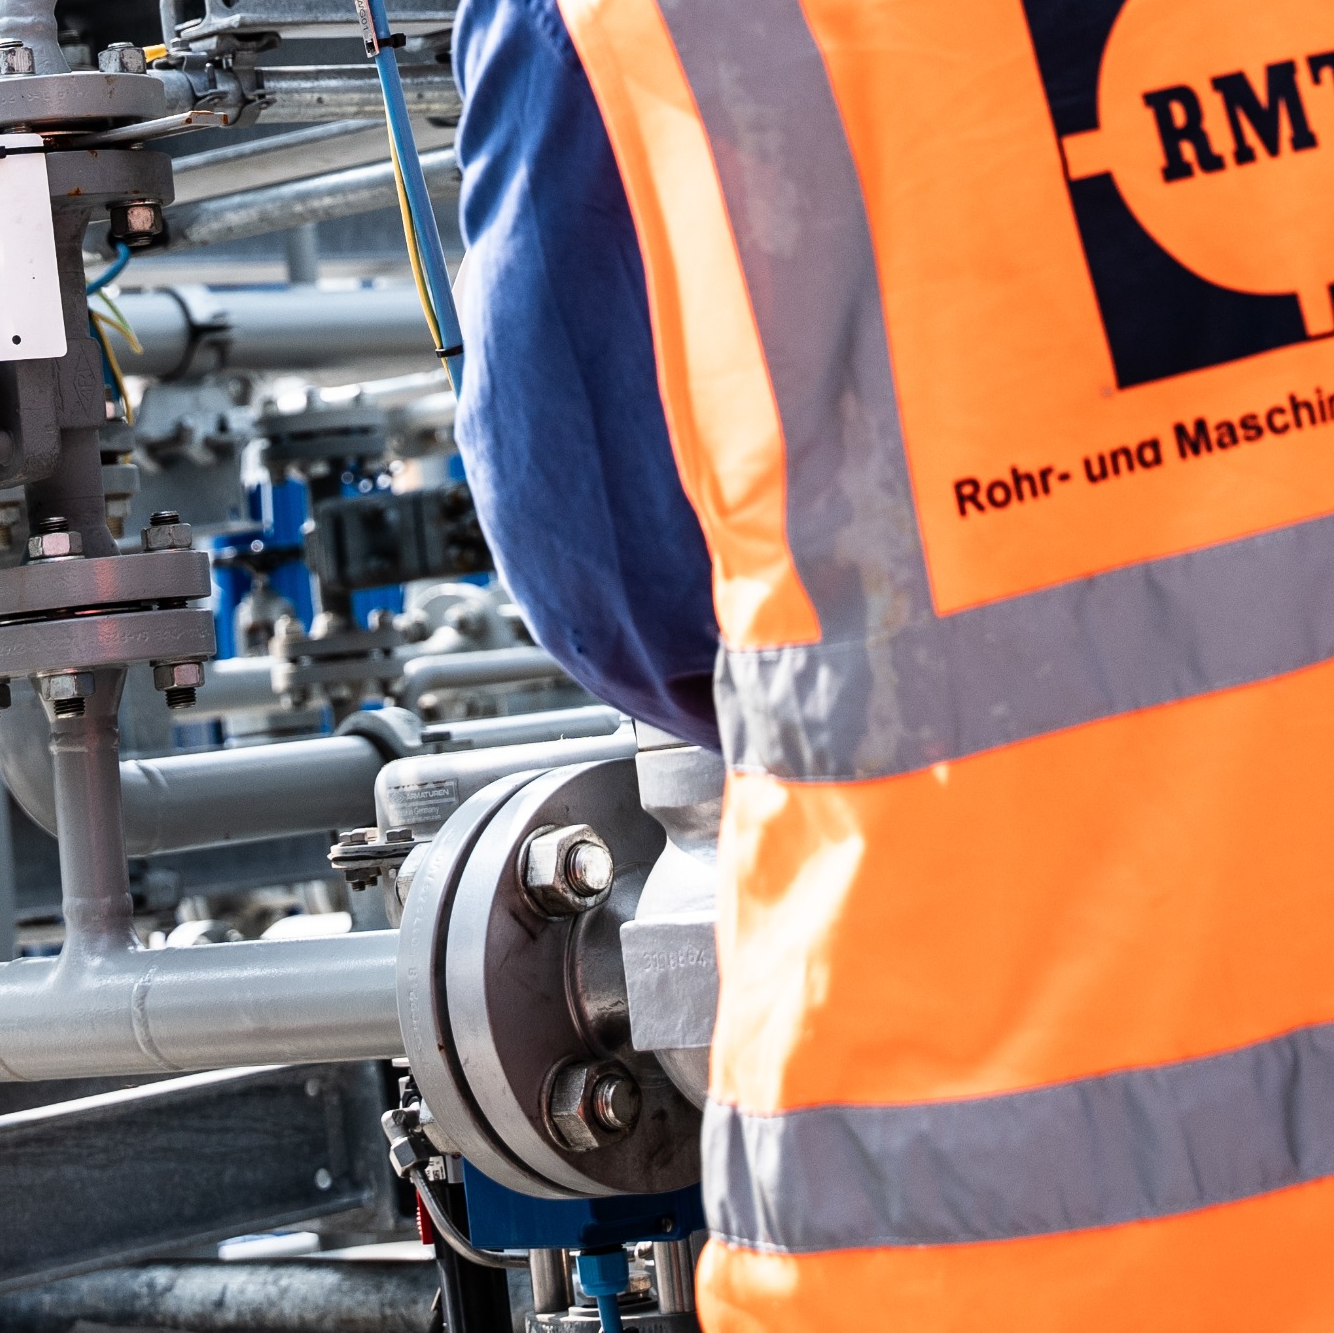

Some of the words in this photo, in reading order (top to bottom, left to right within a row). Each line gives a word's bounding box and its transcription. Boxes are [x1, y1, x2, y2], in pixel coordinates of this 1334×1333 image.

[953, 464, 1072, 518] Rohr-
[406, 788, 450, 800] ARMATUREN
[413, 806, 440, 816] Germany
